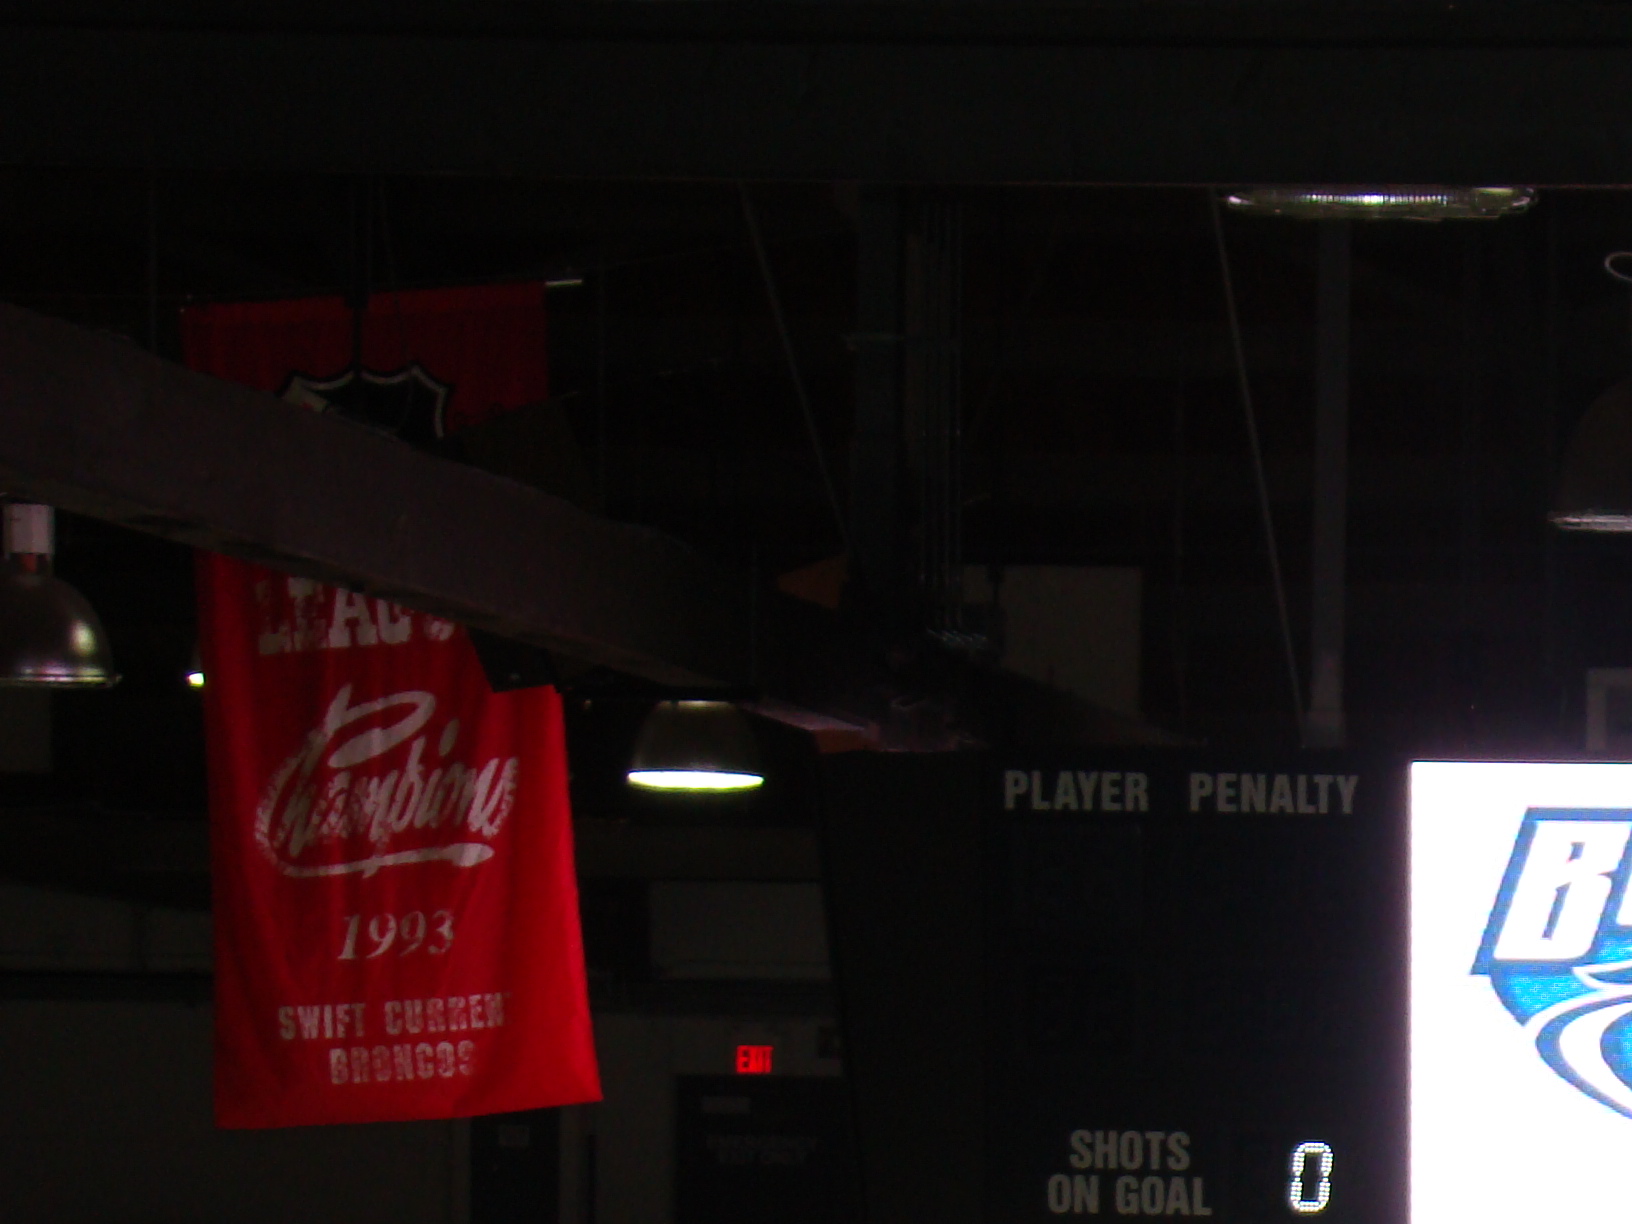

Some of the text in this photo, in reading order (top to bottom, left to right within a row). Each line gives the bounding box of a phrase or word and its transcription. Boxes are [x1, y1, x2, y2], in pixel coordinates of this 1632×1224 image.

[1003, 769, 1360, 814] PLAYER PENALTY
[337, 908, 456, 961] 1993
[278, 1002, 367, 1041] SWIFT
[328, 1039, 478, 1085] BRONCOS
[1069, 1129, 1191, 1171] SHOTS
[1048, 1174, 1213, 1216] ON GOAL
[1289, 1140, 1334, 1213] 0
